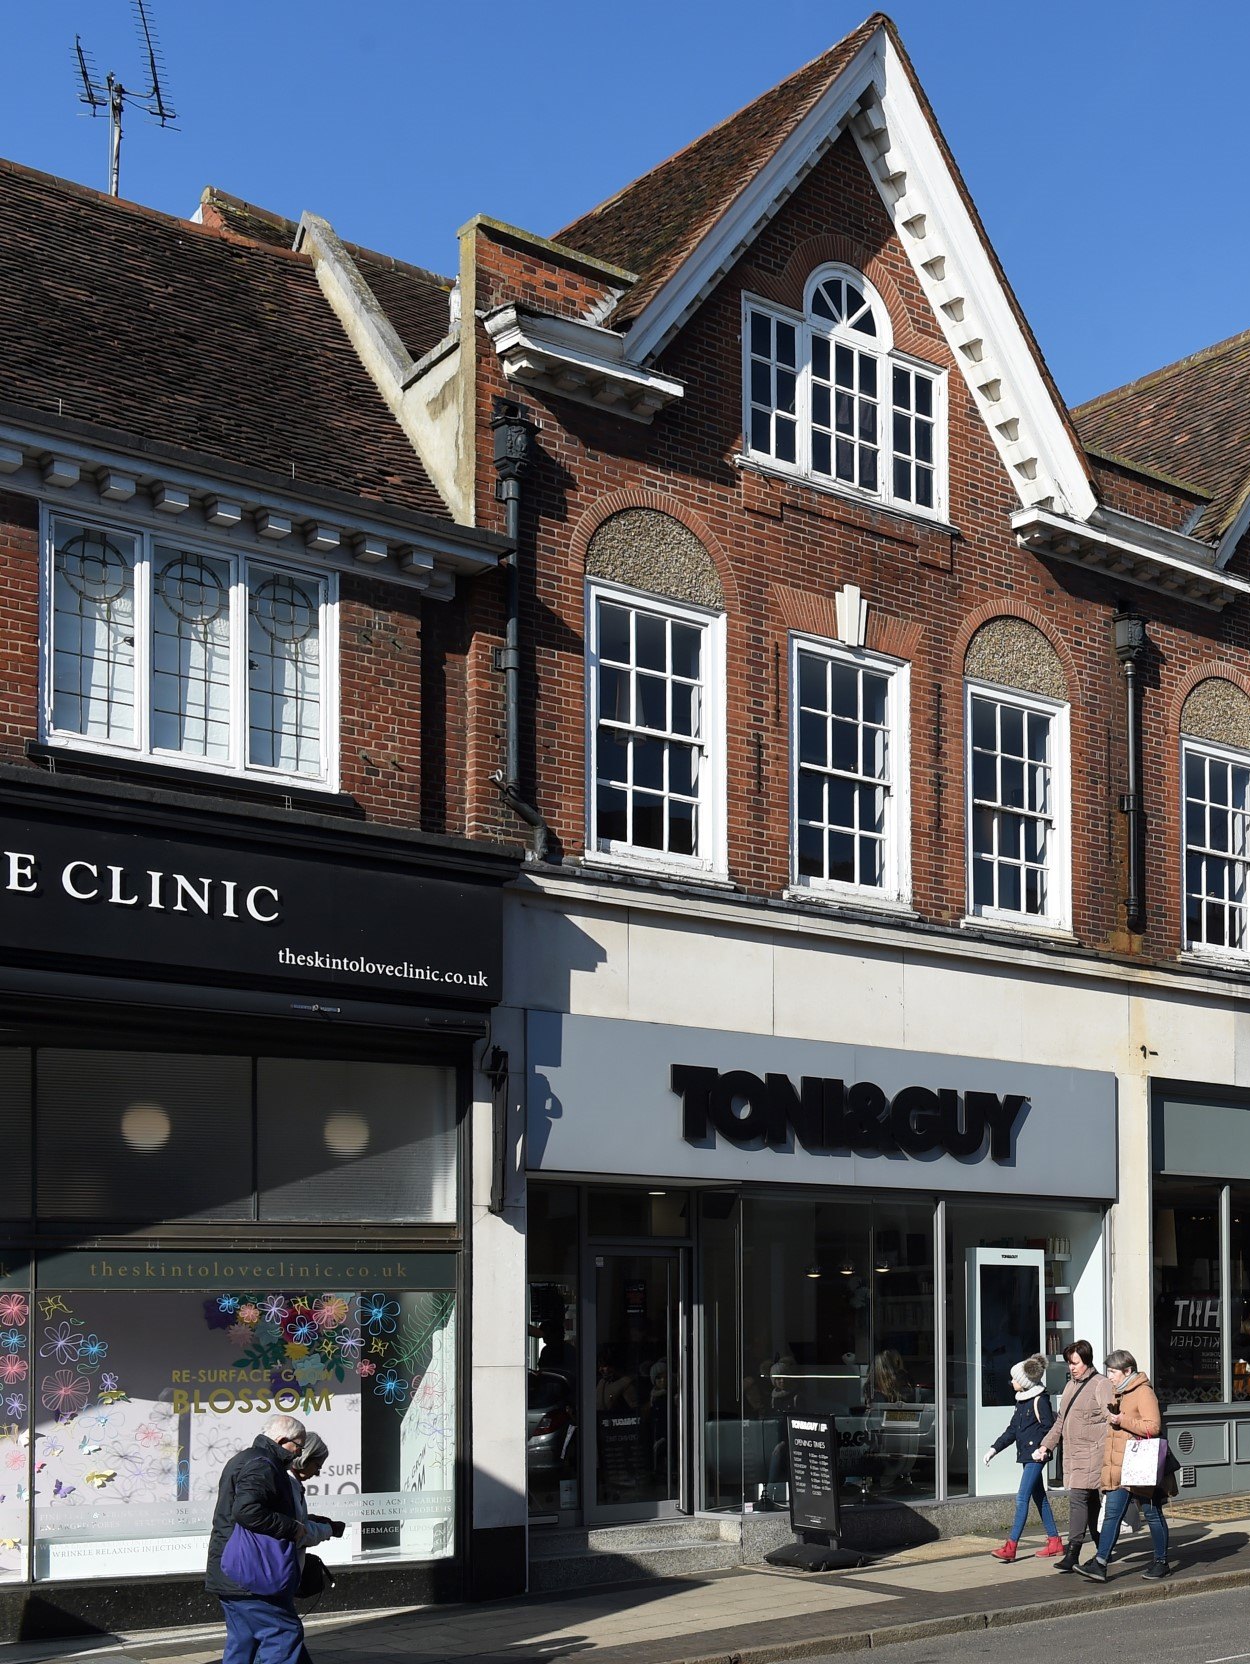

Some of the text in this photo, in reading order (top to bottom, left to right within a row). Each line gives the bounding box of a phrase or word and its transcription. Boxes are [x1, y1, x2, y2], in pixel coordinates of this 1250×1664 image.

[61, 861, 281, 922] CLINIC
[278, 948, 488, 987] theskintoloveclinic.co.uk
[670, 1064, 1030, 1159] TONI&GUY
[90, 1261, 408, 1278] theskintoloveclinic.co.uk
[172, 1369, 276, 1385] RE-SURFACE,
[172, 1388, 333, 1415] BLOSSOM
[52, 1549, 93, 1558] WRINKLE
[95, 1547, 141, 1556] RELAXING
[142, 1543, 192, 1553] INJECTIONS
